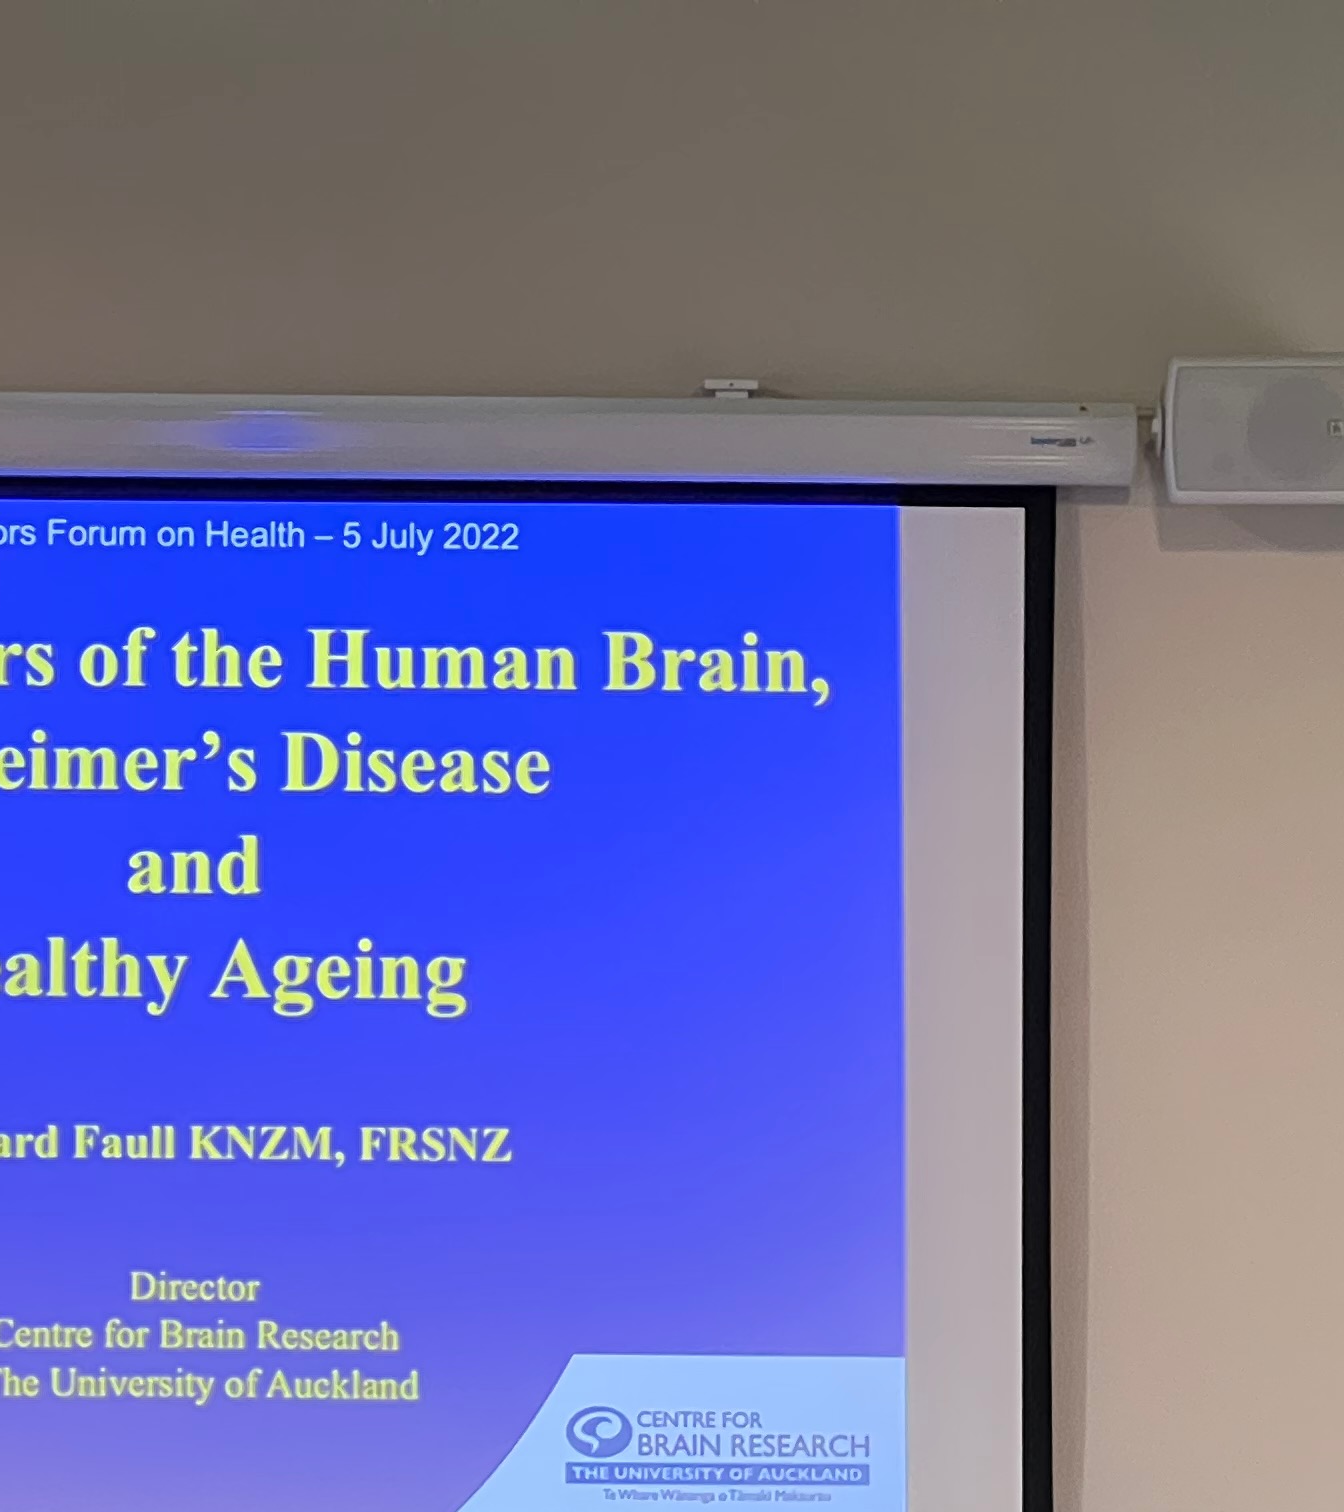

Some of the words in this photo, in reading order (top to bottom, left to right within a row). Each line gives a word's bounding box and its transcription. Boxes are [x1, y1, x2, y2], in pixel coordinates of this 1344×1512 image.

[47, 518, 147, 547] Forum
[156, 526, 195, 547] on
[205, 519, 305, 548] Health
[342, 521, 362, 549] 5
[371, 521, 434, 557] July
[442, 522, 520, 551] 2022
[78, 625, 156, 688] of
[170, 627, 284, 689] the
[305, 627, 579, 691] Human
[601, 630, 831, 707] Brain,
[279, 730, 551, 795] Disease
[126, 833, 263, 896] and
[209, 936, 468, 1019] Ageing
[73, 1123, 176, 1160] Faull
[189, 1124, 346, 1168] KNZM,
[359, 1126, 513, 1163] FRSNZ
[130, 1270, 262, 1302] Director
[104, 1317, 151, 1349] for
[159, 1318, 246, 1350] Brain
[257, 1319, 400, 1352] Research
[50, 1366, 215, 1406] University
[224, 1367, 263, 1399] of
[266, 1368, 419, 1401] Auckland
[636, 1410, 716, 1428] CENTRE
[721, 1411, 763, 1429] FOR
[638, 1433, 721, 1457] BRAIN
[730, 1434, 870, 1458] RESEARCH
[572, 1466, 609, 1480] THE
[614, 1466, 724, 1481] UNIVERSITY
[729, 1467, 753, 1481] OF
[758, 1467, 863, 1482] AUCKLAND
